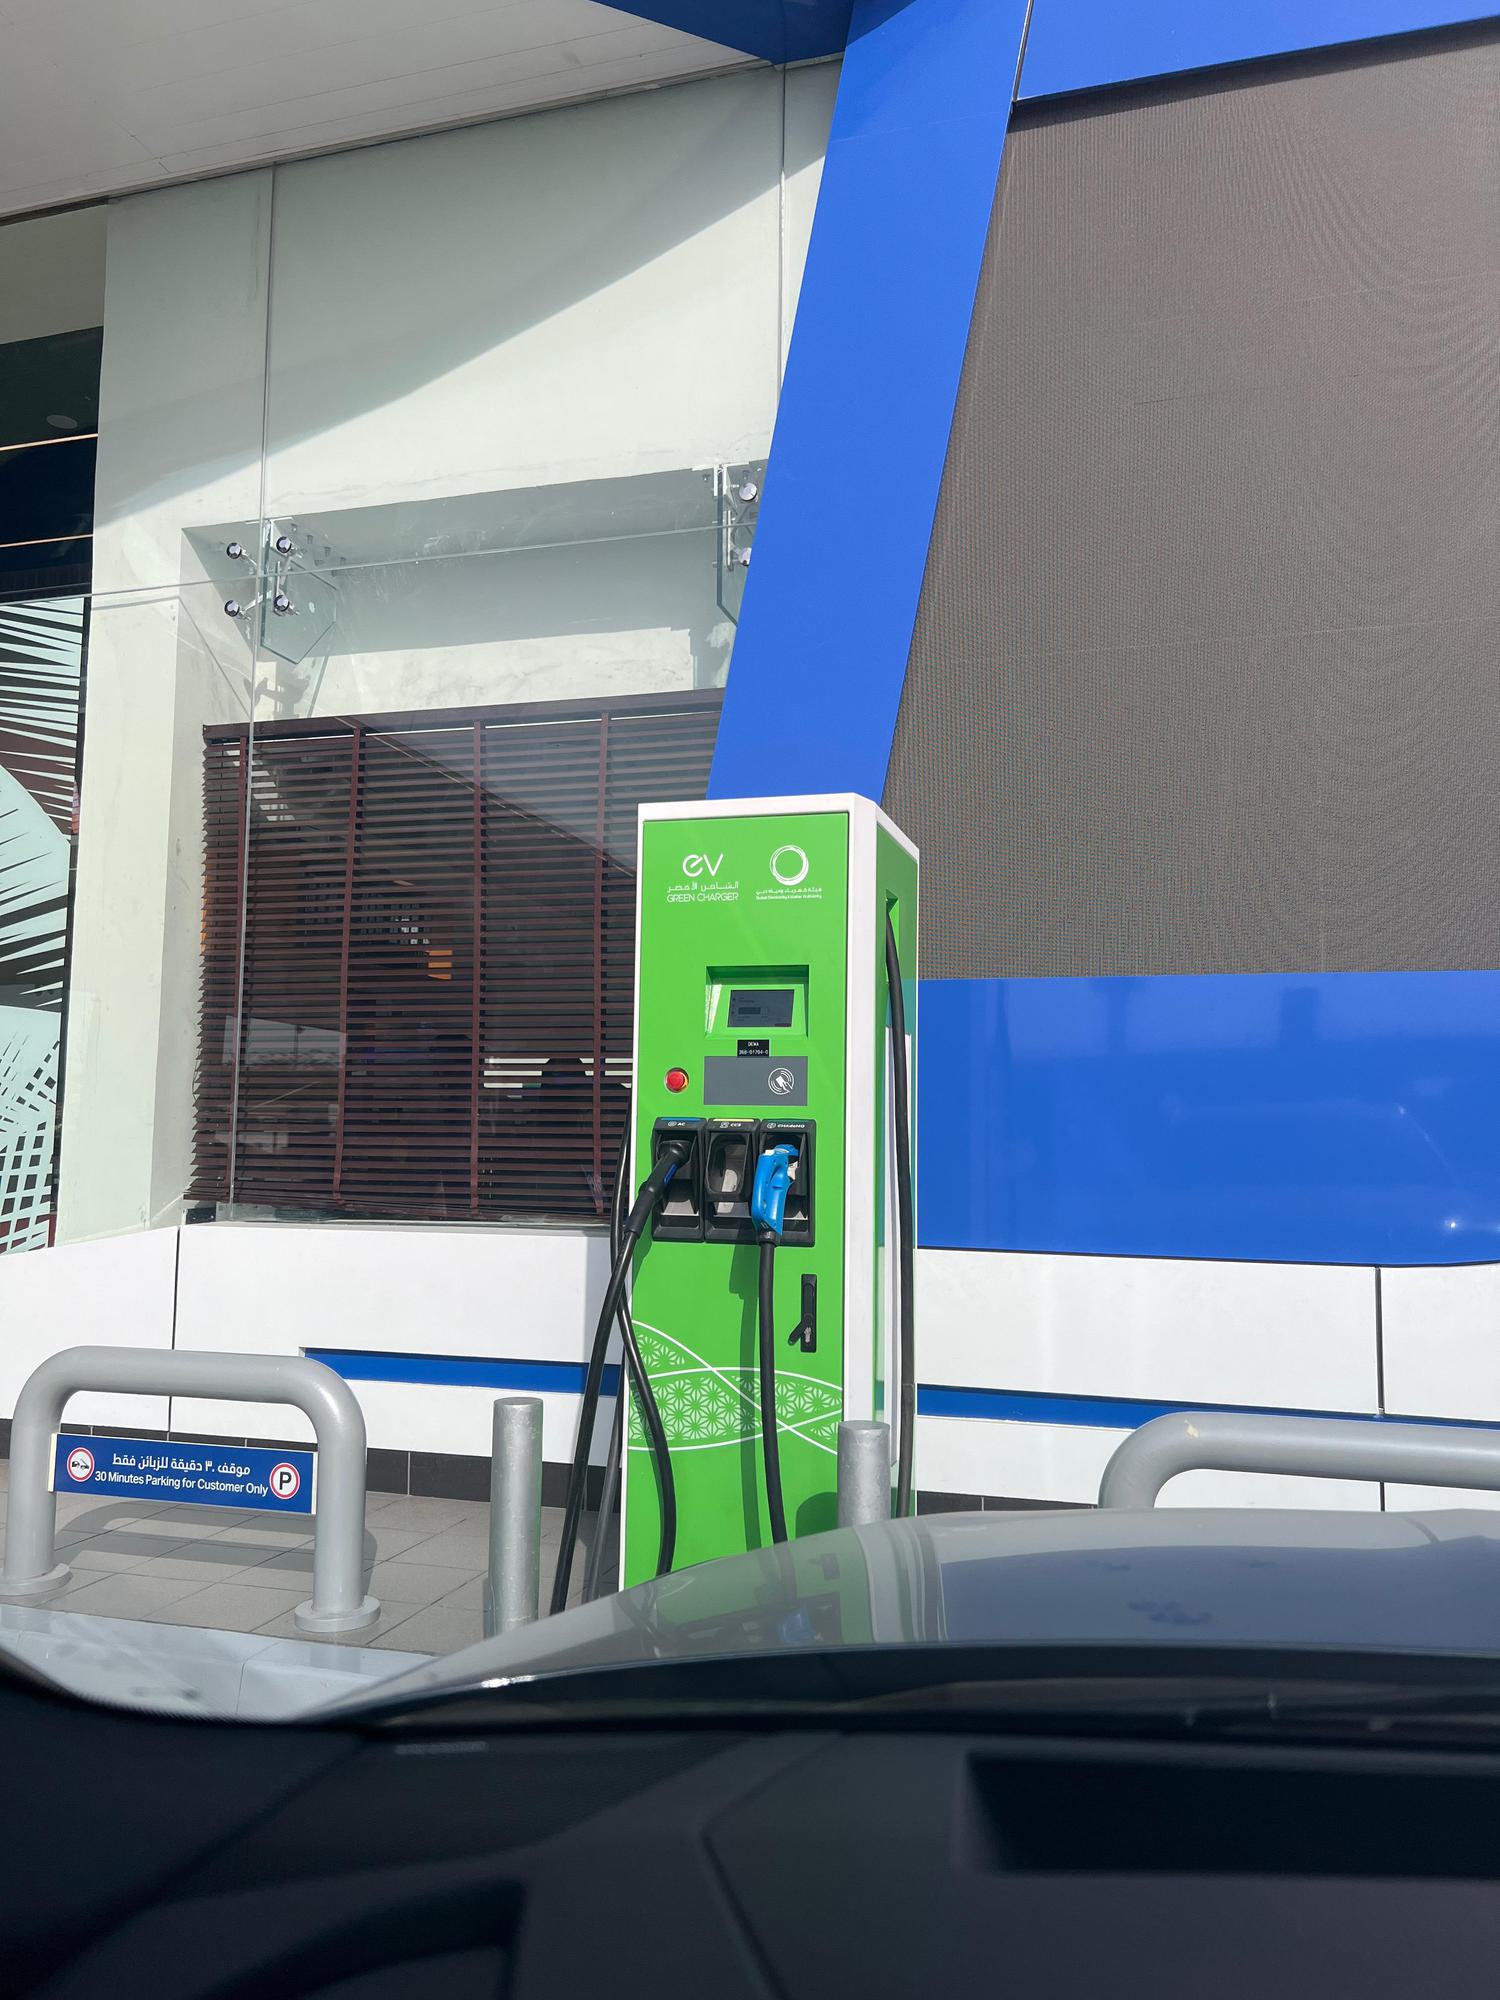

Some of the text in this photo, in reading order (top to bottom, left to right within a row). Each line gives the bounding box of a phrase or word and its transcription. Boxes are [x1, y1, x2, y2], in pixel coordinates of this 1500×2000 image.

[666, 892, 739, 903] GREEN CHARGER
[112, 1453, 136, 1467] فقط
[138, 1456, 169, 1472] للزبائن
[170, 1457, 203, 1473] دقيقة
[217, 1462, 251, 1478] موقف
[94, 1471, 269, 1498] 30 Minutes Parking for Customer Only
[279, 1471, 292, 1490] P
